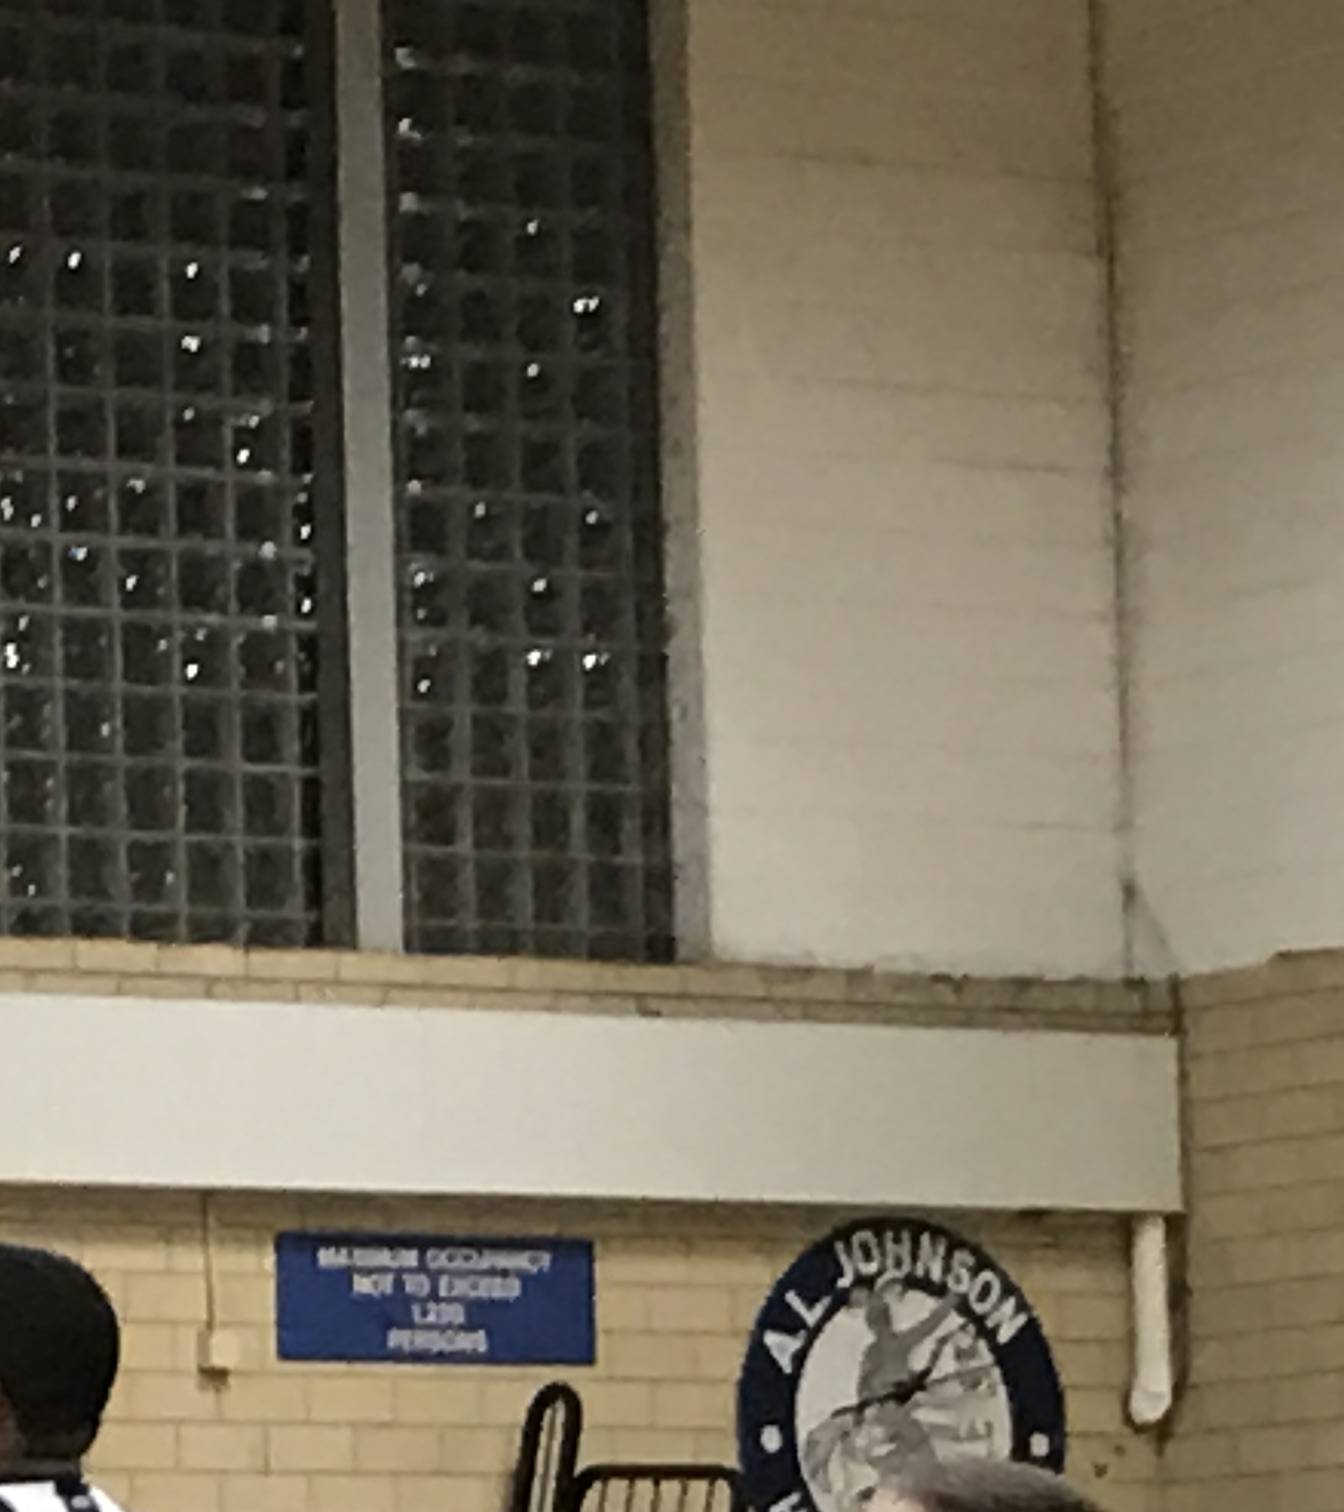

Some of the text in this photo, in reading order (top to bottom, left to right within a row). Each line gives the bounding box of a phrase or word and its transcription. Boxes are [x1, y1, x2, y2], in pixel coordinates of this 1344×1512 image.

[426, 1248, 552, 1274] OCCUPANCY
[353, 1273, 522, 1301] NOT TO EXCEED
[763, 1228, 1029, 1374] AL JOHNSON
[387, 1327, 488, 1353] PERSONS
